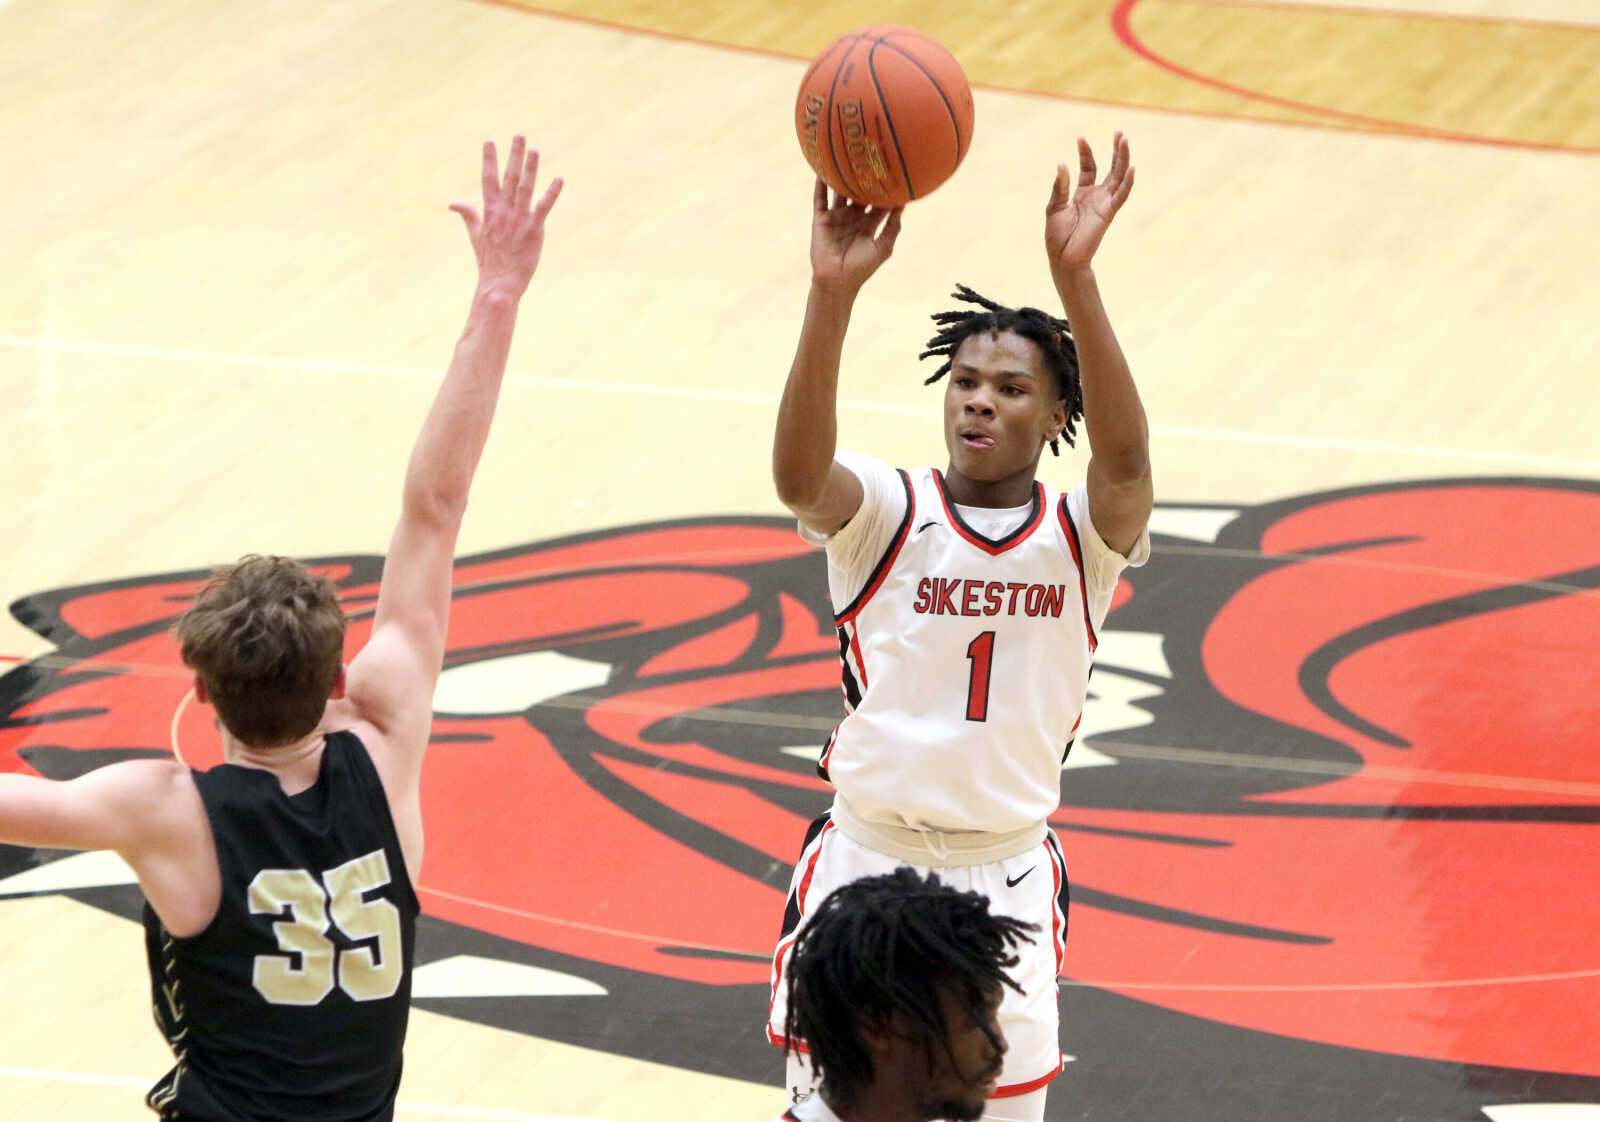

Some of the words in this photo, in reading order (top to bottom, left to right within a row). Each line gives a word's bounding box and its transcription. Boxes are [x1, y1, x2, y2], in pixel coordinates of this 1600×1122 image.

[914, 577, 1066, 618] SIKESTON
[965, 631, 996, 723] 1
[247, 848, 404, 1006] 35
